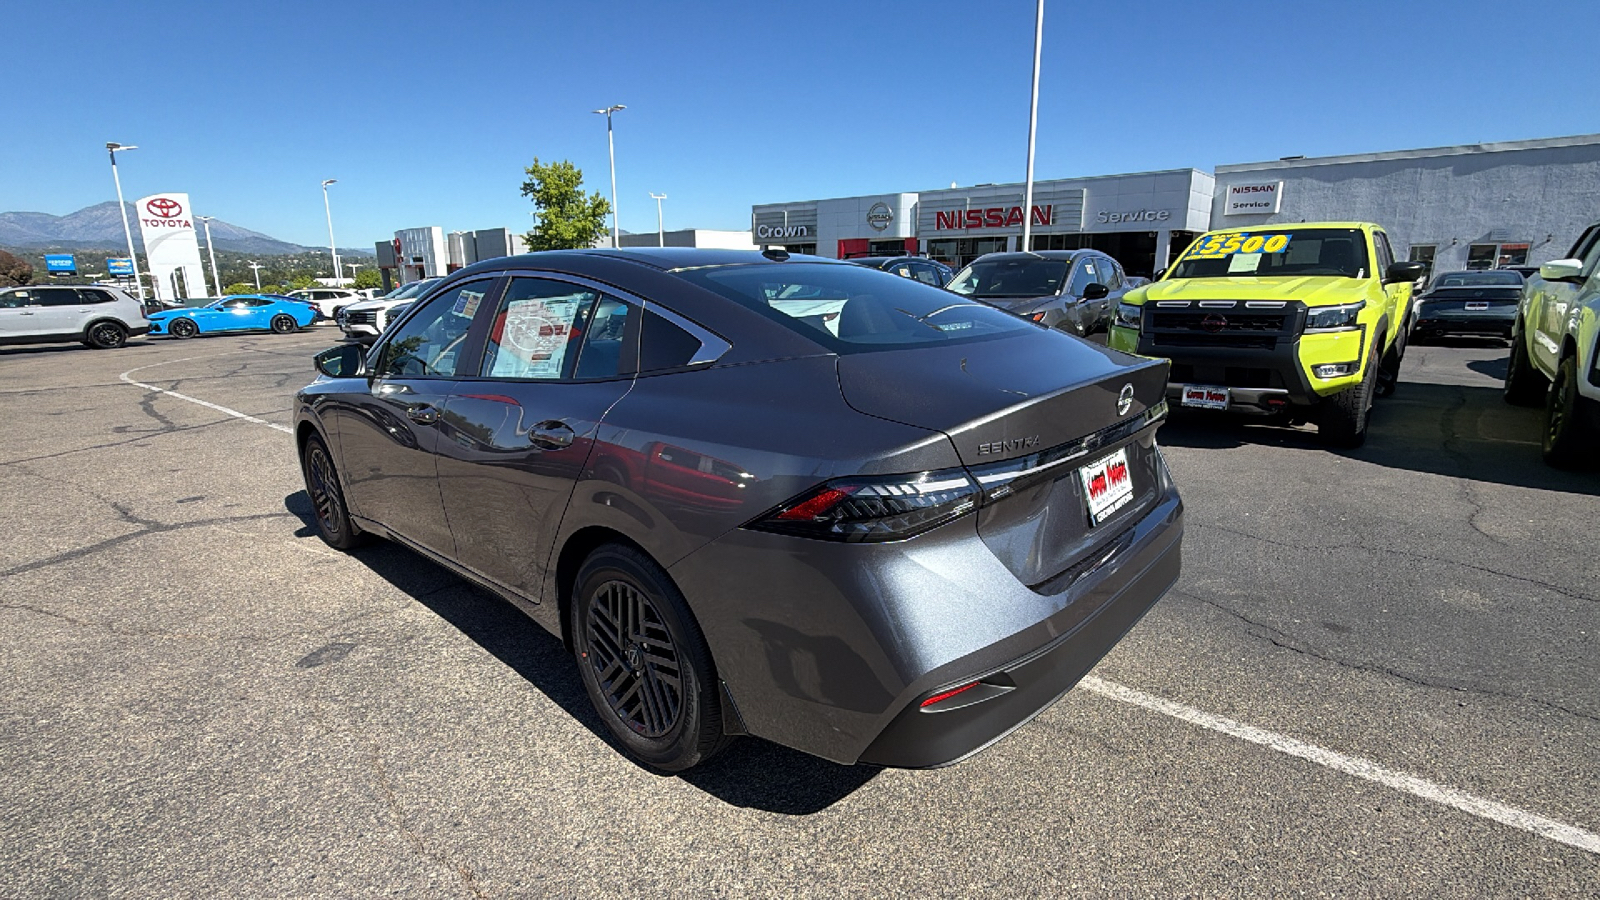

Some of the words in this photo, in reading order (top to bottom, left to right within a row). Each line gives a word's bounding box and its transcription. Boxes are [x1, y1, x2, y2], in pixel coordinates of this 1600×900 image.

[1232, 185, 1275, 194] NISSAN
[1233, 201, 1270, 209] Service
[142, 218, 192, 228] TOYOTA
[935, 204, 1053, 230] NISSAN
[1097, 209, 1170, 224] Service
[757, 225, 808, 238] Crown
[978, 435, 1039, 455] SENTRA
